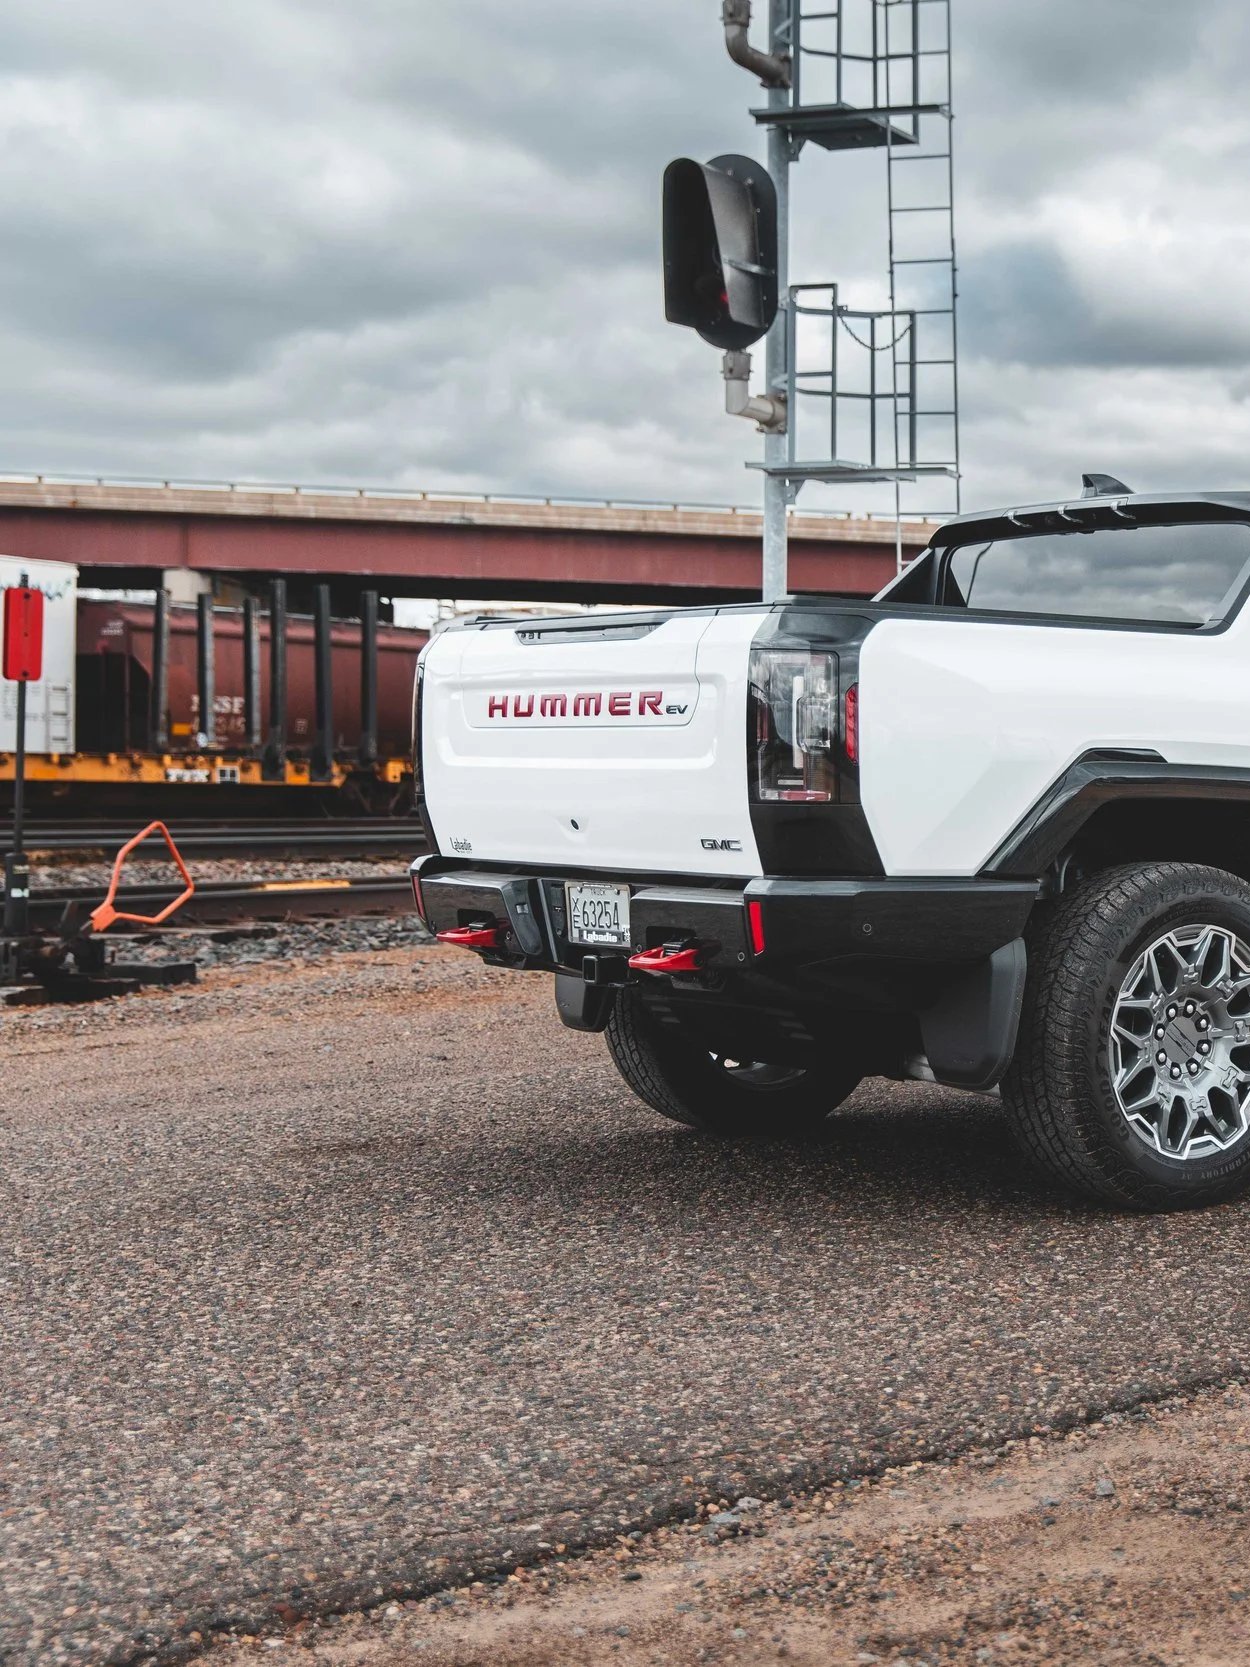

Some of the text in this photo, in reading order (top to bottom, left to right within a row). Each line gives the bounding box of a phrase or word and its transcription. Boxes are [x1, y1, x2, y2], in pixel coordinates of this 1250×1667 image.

[190, 693, 245, 715] SF
[488, 691, 689, 718] HUMMER EV
[449, 836, 473, 853] Labadie
[700, 838, 743, 852] GMC
[582, 900, 620, 930] 63254
[582, 930, 618, 943] Labadie
